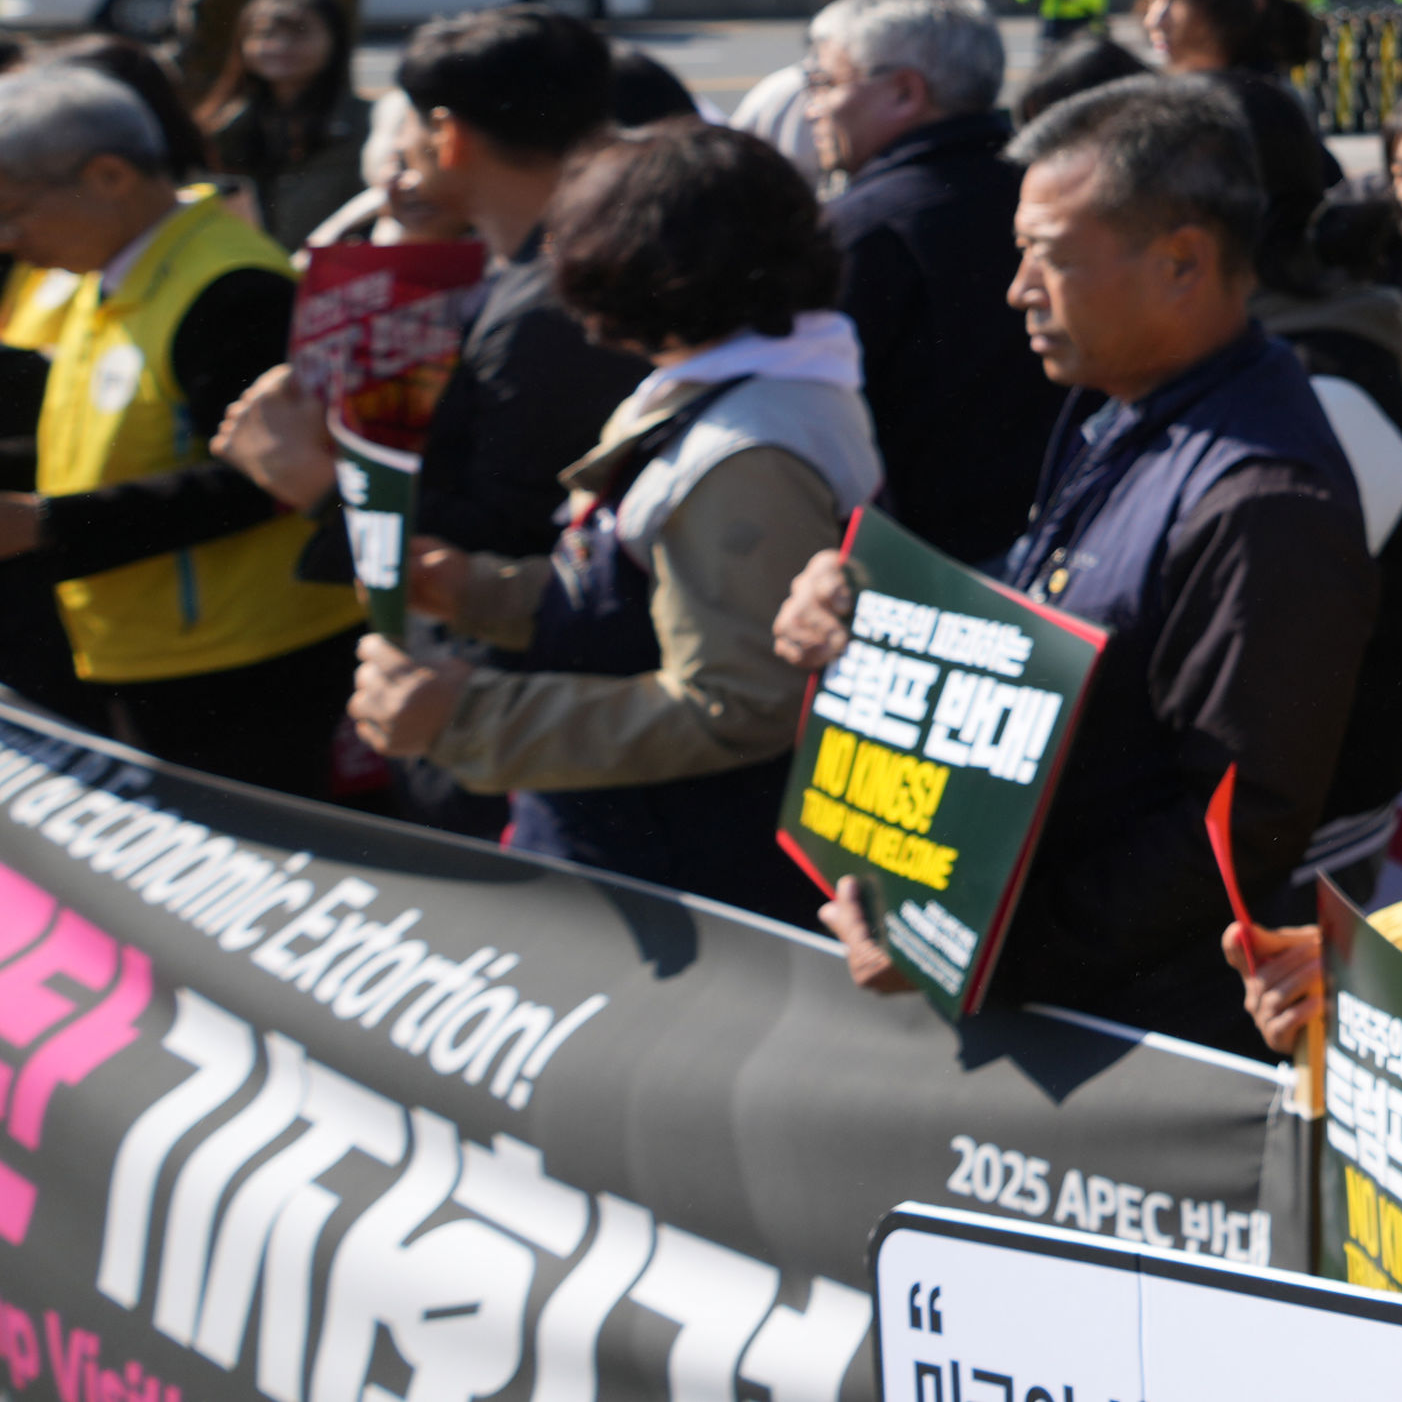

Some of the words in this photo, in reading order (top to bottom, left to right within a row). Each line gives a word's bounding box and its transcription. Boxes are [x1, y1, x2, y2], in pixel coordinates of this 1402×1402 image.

[812, 639, 940, 750] 트럼프
[923, 669, 1064, 786] 반대!
[812, 725, 858, 798] NO
[844, 739, 951, 835] KINGS!
[40, 789, 314, 953] Economic
[250, 875, 609, 1112] Extortion!
[945, 1133, 1053, 1217] 2025
[1054, 1168, 1175, 1251] APEC
[1344, 1164, 1380, 1259] NO
